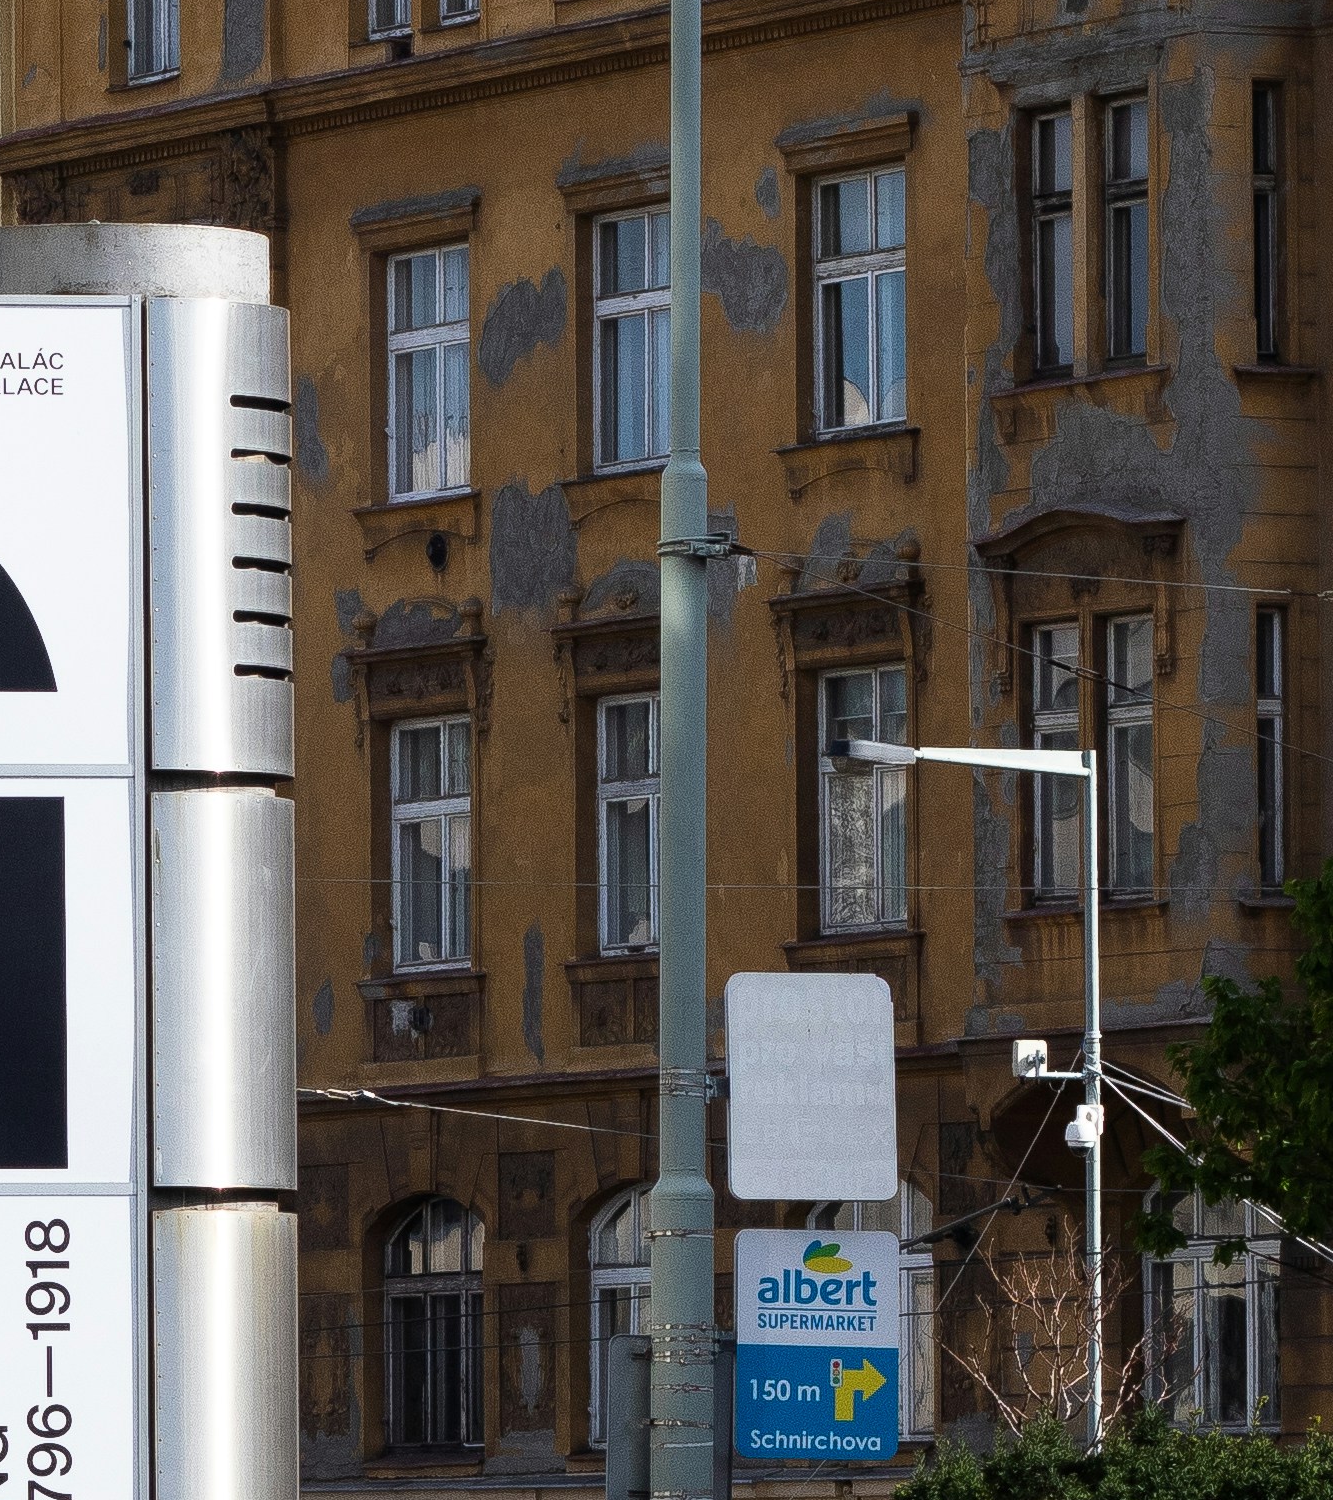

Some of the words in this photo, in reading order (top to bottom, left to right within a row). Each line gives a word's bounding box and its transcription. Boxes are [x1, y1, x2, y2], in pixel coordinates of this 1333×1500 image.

[757, 1269, 878, 1306] albert
[757, 1313, 877, 1332] SUPERMARKET
[749, 1378, 791, 1402] 150
[796, 1382, 820, 1401] m
[750, 1428, 881, 1452] Schnirchova
